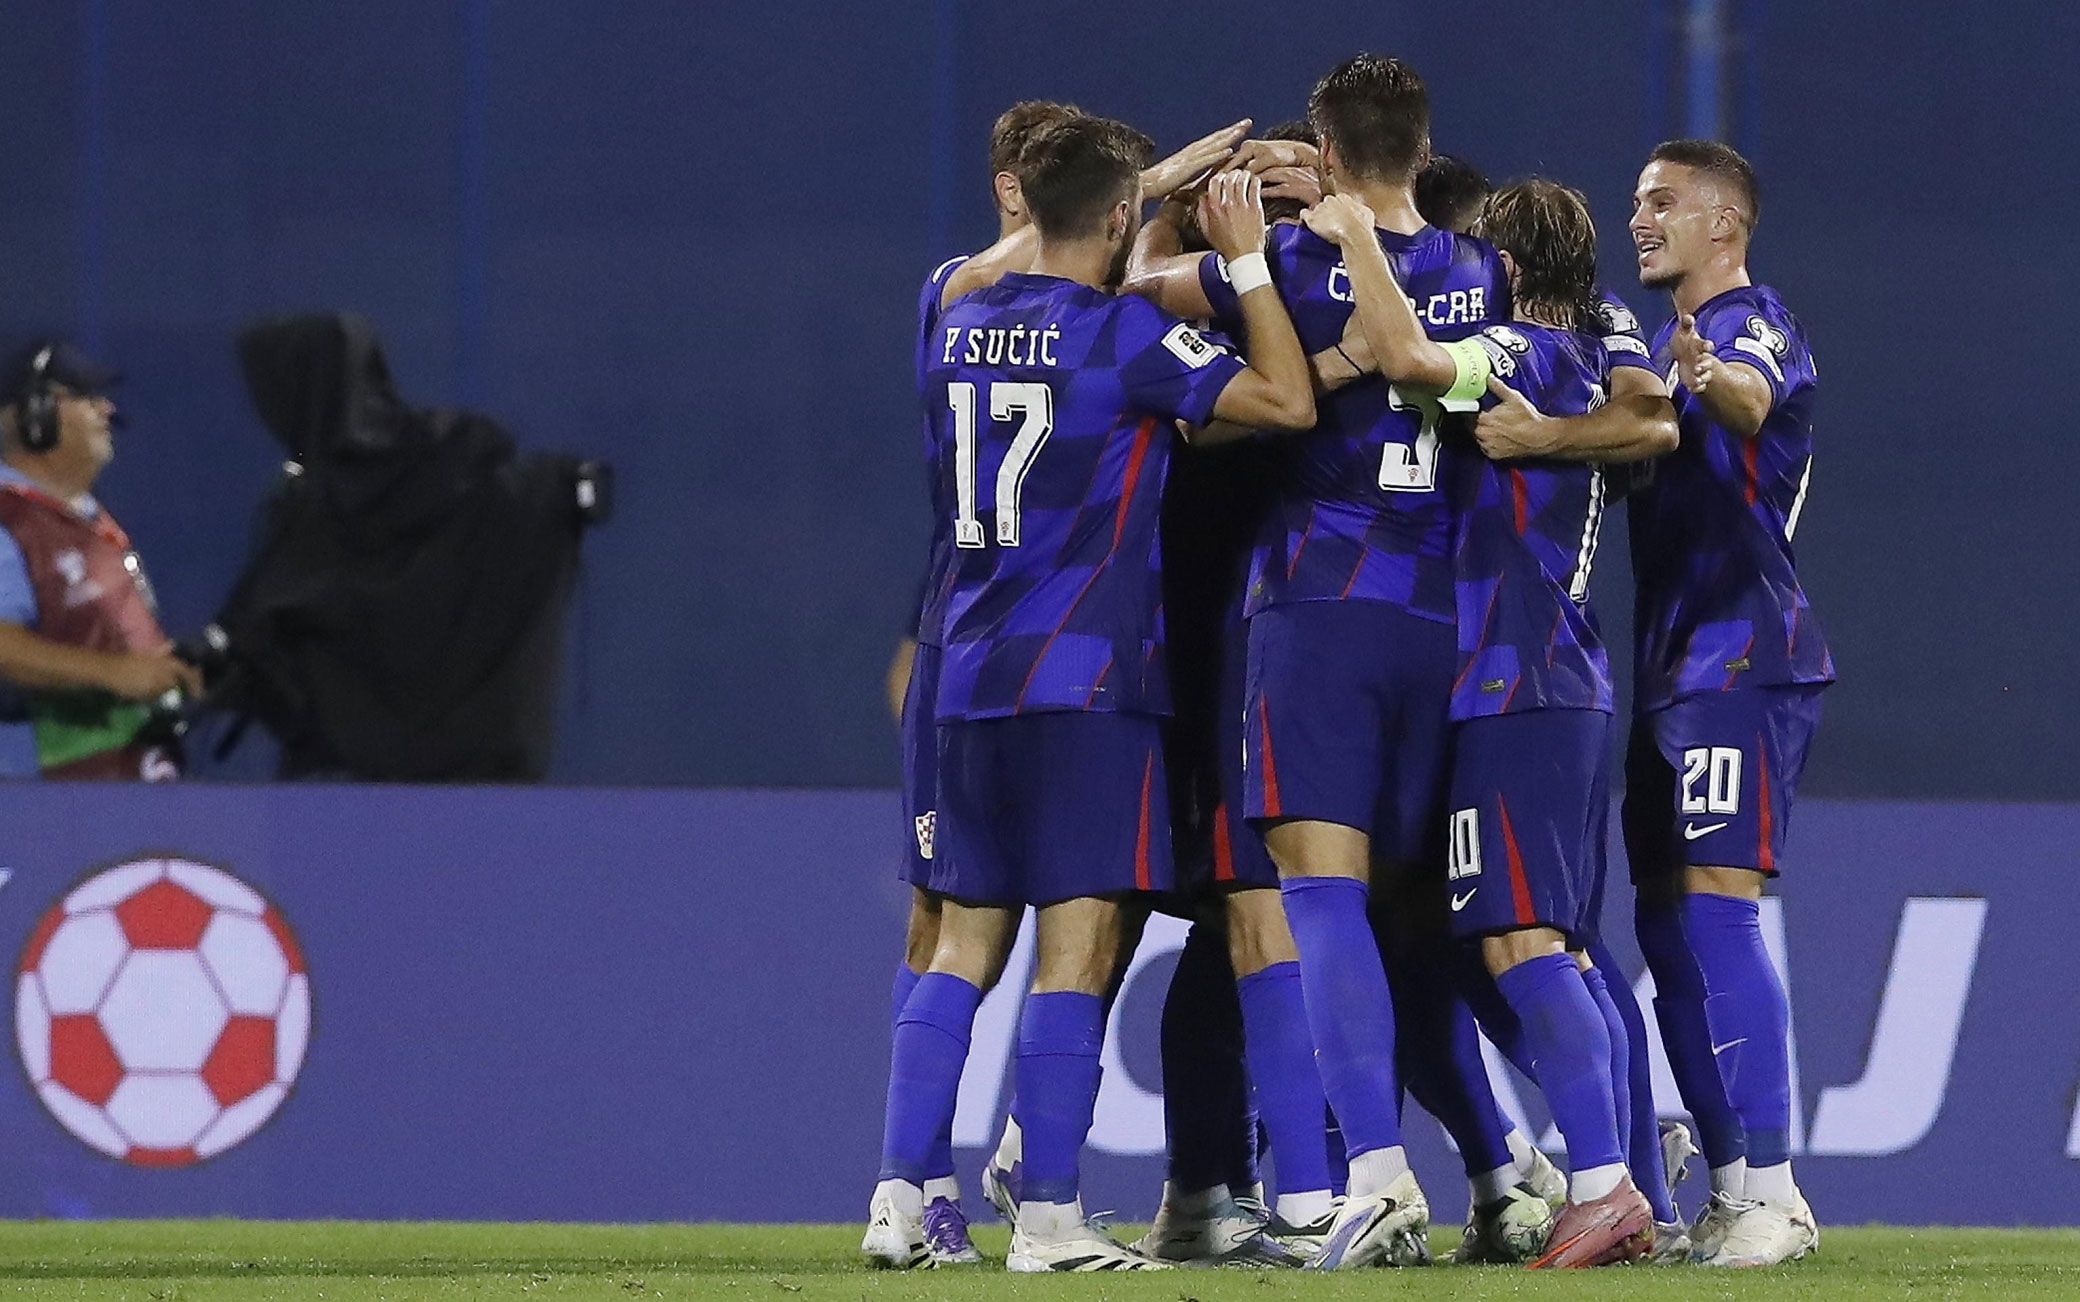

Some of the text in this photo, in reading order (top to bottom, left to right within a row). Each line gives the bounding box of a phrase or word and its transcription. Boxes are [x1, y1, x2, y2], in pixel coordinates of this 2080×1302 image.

[964, 322, 1061, 367] SUĆIĆ
[948, 382, 1053, 548] 17
[1682, 747, 1742, 815] 20
[1448, 808, 1482, 881] 10
